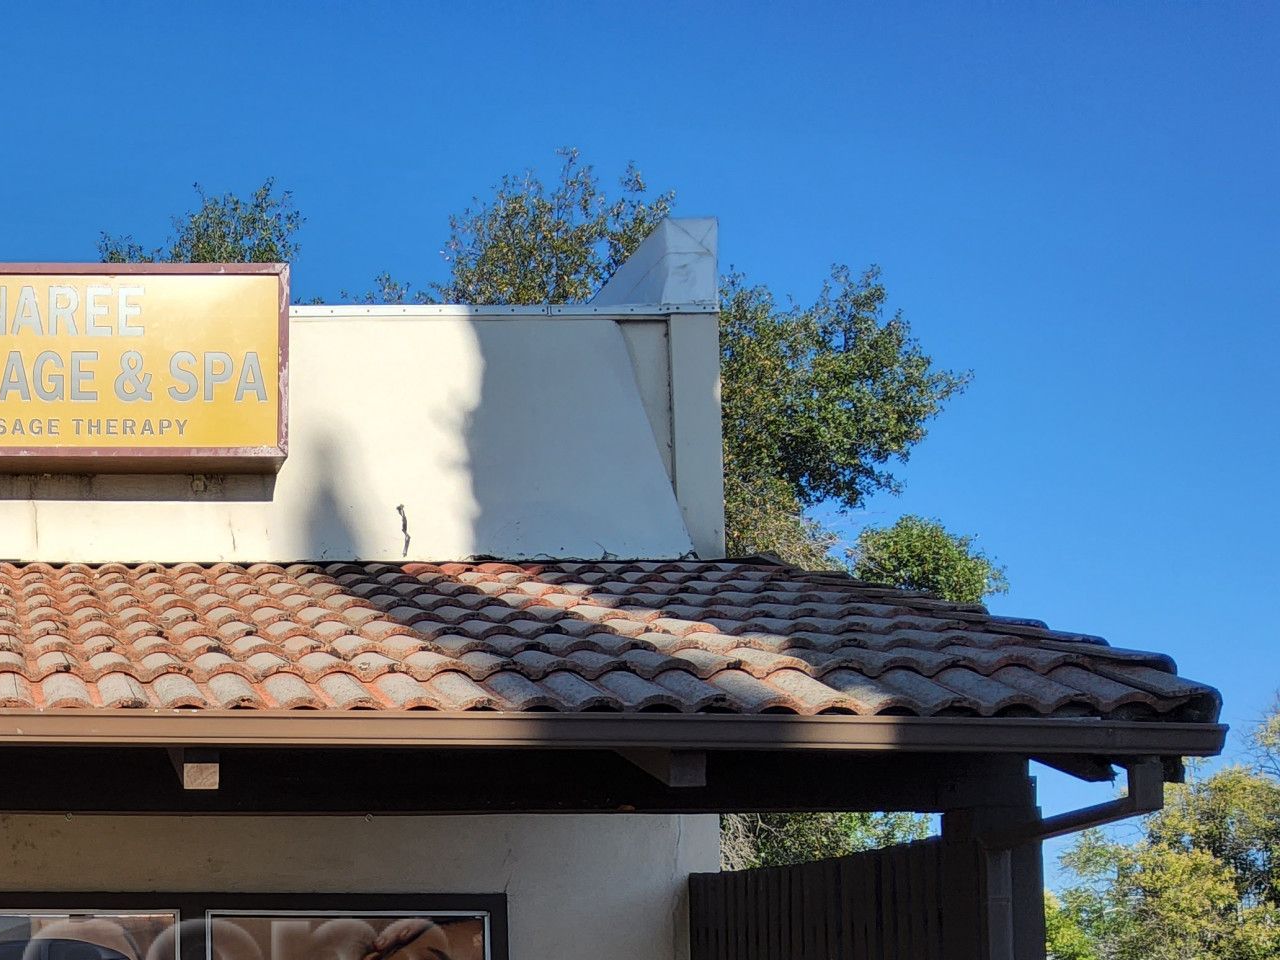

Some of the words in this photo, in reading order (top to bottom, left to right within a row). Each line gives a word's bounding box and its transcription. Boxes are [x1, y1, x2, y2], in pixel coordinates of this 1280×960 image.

[113, 349, 153, 401] &
[168, 350, 268, 402] SPA
[72, 417, 189, 436] THERAPY
